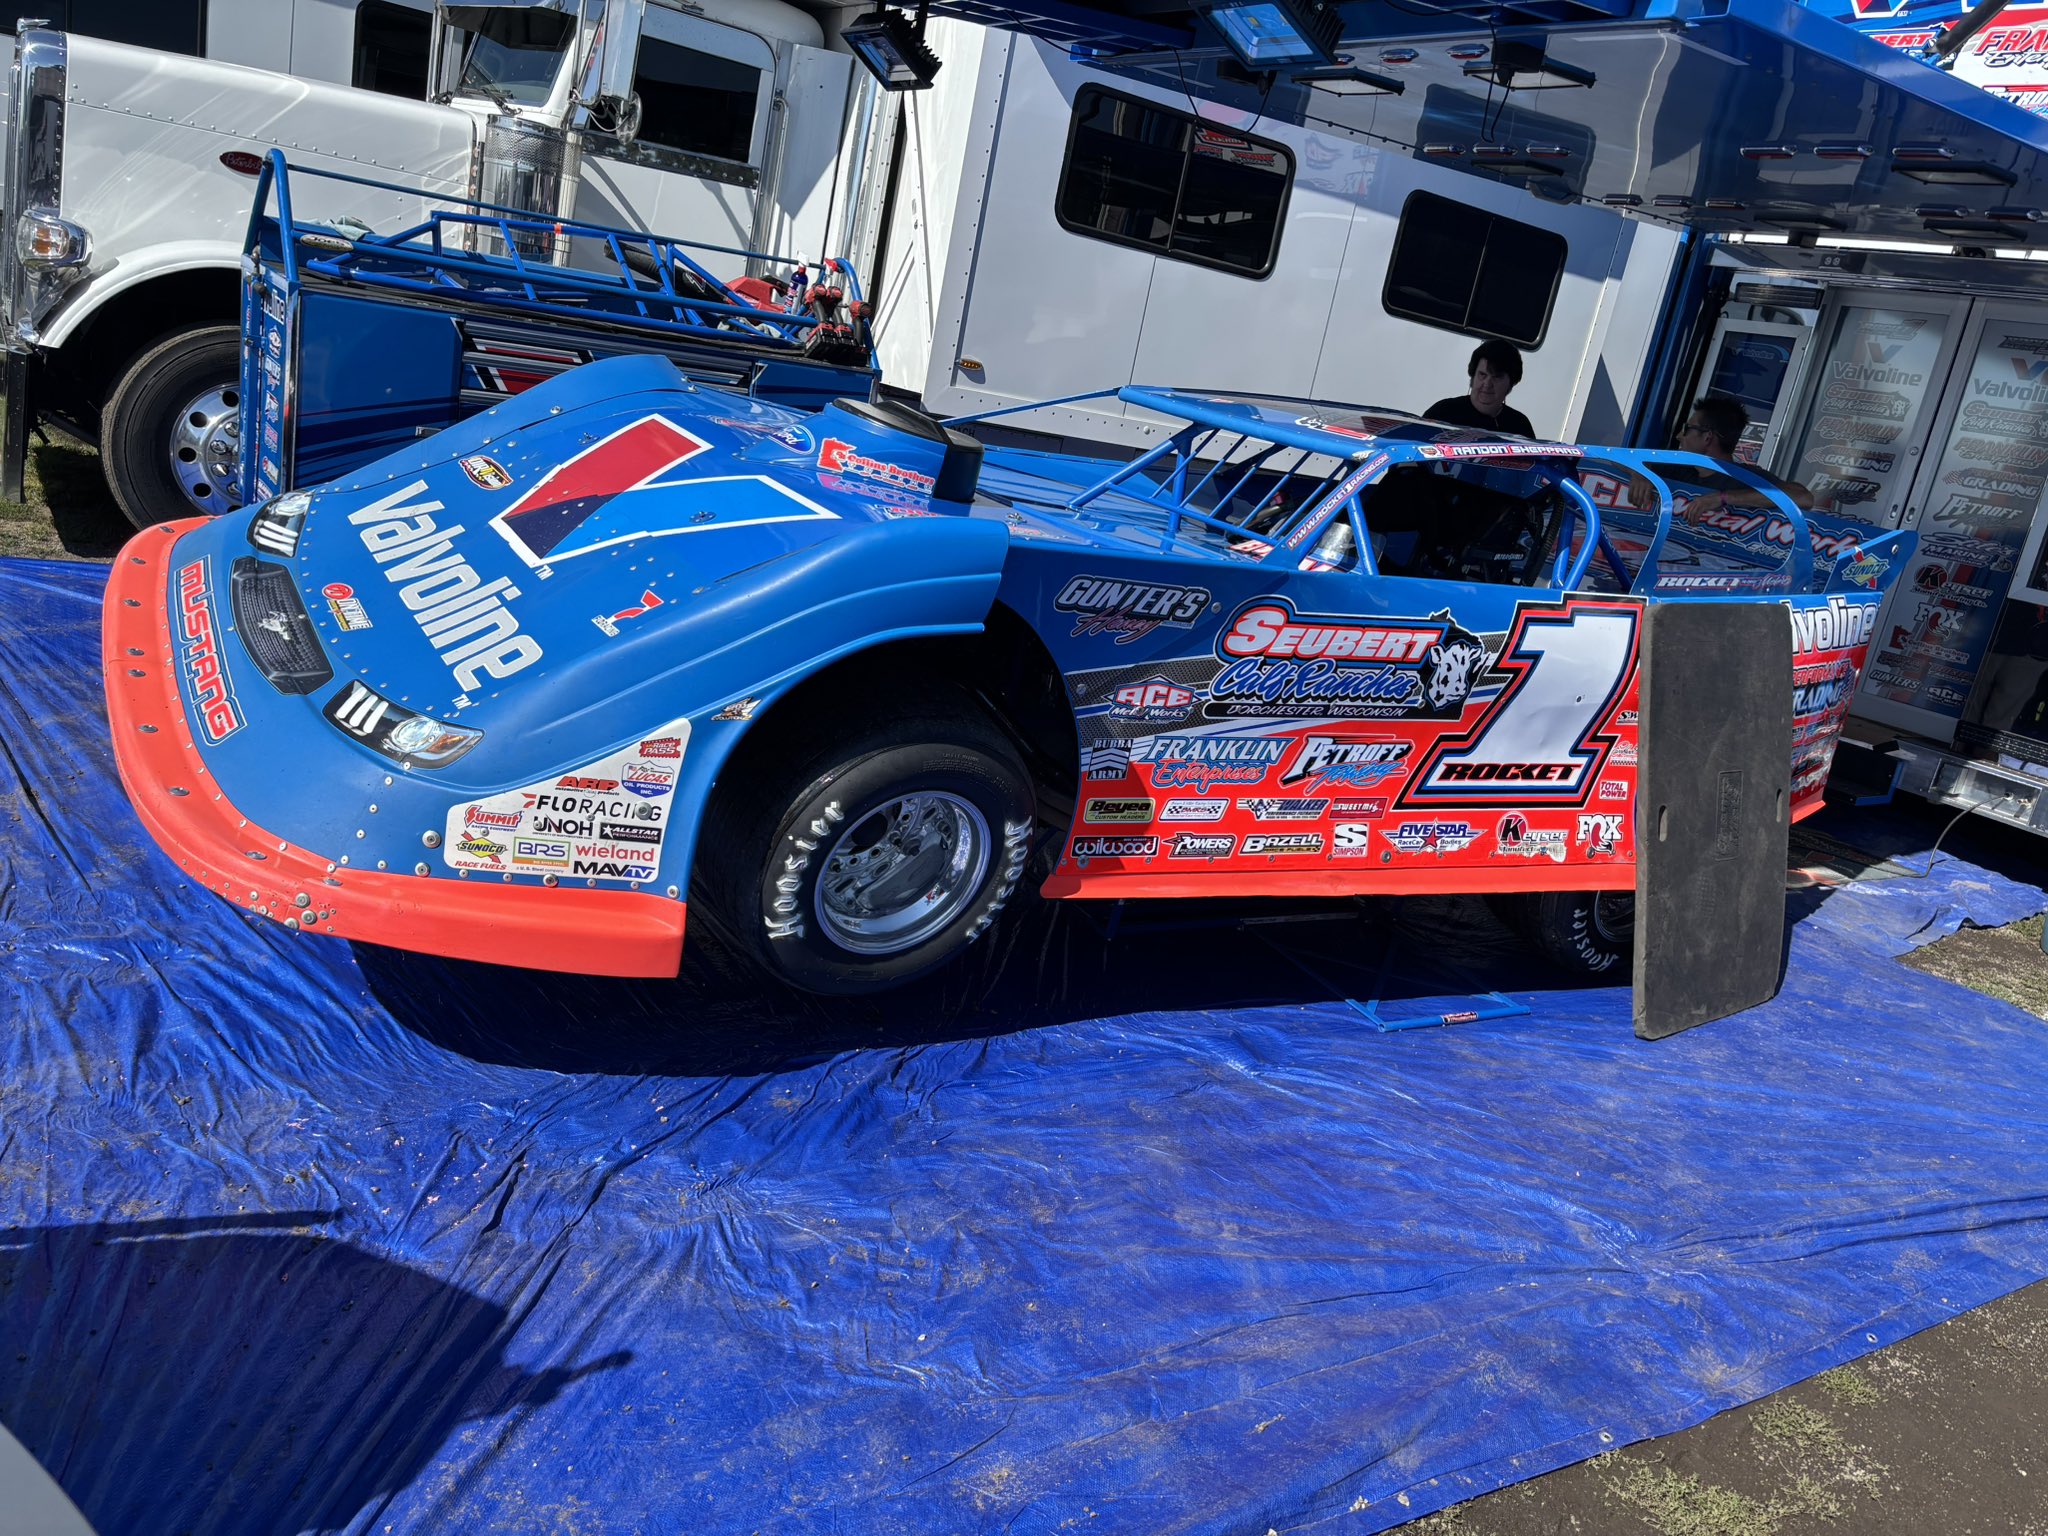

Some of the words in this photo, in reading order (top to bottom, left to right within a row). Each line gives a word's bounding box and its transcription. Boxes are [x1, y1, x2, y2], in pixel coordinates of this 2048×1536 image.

[1976, 29, 2048, 54] FRA
[1833, 360, 1923, 387] Valvoline
[1510, 445, 1582, 456] SHEPPARD
[847, 453, 888, 471] Collins
[888, 464, 936, 486] Brothers
[1824, 454, 1893, 473] GRADING
[1807, 472, 1880, 493] PETROFF
[1962, 476, 2039, 497] GRADING
[1941, 494, 2022, 521] PETROFF
[1926, 544, 1992, 562] MARINE
[1847, 563, 1889, 577] SUNOCO
[347, 480, 544, 692] Valvoline
[1657, 577, 1741, 587] ROCKET
[1917, 566, 1994, 600] Keyser
[1057, 578, 1207, 618] GUNTER'S
[1782, 596, 1878, 654] lvoline
[1225, 608, 1439, 662] SEUBERT
[174, 558, 248, 741] MUSTANG
[1211, 655, 1299, 701] Calf
[1290, 658, 1418, 701] Ranches
[1416, 604, 1640, 798] 1
[1149, 707, 1187, 718] Works
[1329, 705, 1409, 717] WISCONSIN
[643, 747, 676, 755] PASS
[1094, 738, 1134, 749] BUBBA
[1143, 736, 1290, 763] FRANKLIN
[1282, 737, 1410, 782] PETROFF
[627, 768, 672, 784] LUCAS
[1089, 769, 1126, 780] ARMY
[1154, 759, 1264, 790] Enterprises
[1436, 763, 1583, 782] ROCKET
[555, 775, 620, 791] ARP
[636, 782, 671, 792] PRODUCTS
[1600, 782, 1624, 791] TOTAL
[1600, 789, 1627, 798] POWER
[1089, 799, 1150, 814] Beyea
[1279, 799, 1329, 811] WALKER
[1338, 803, 1362, 812] SWEET
[533, 814, 594, 837] UNOH
[612, 826, 659, 836] ALLSTAR
[1399, 824, 1432, 838] FIVE
[1435, 824, 1468, 837] STAR
[1499, 818, 1568, 843] Keyser
[1577, 814, 1623, 850] FOX
[1241, 834, 1323, 854] BAZELL
[1334, 823, 1368, 848] S
[459, 841, 506, 854] SUNOCO
[517, 841, 566, 858] BRS
[575, 842, 655, 863] wieland
[1074, 837, 1157, 855] wilwood
[1174, 836, 1233, 855] POWERS
[1333, 848, 1364, 856] SIMPSON
[454, 860, 479, 868] RACE
[479, 862, 507, 871] FUELS
